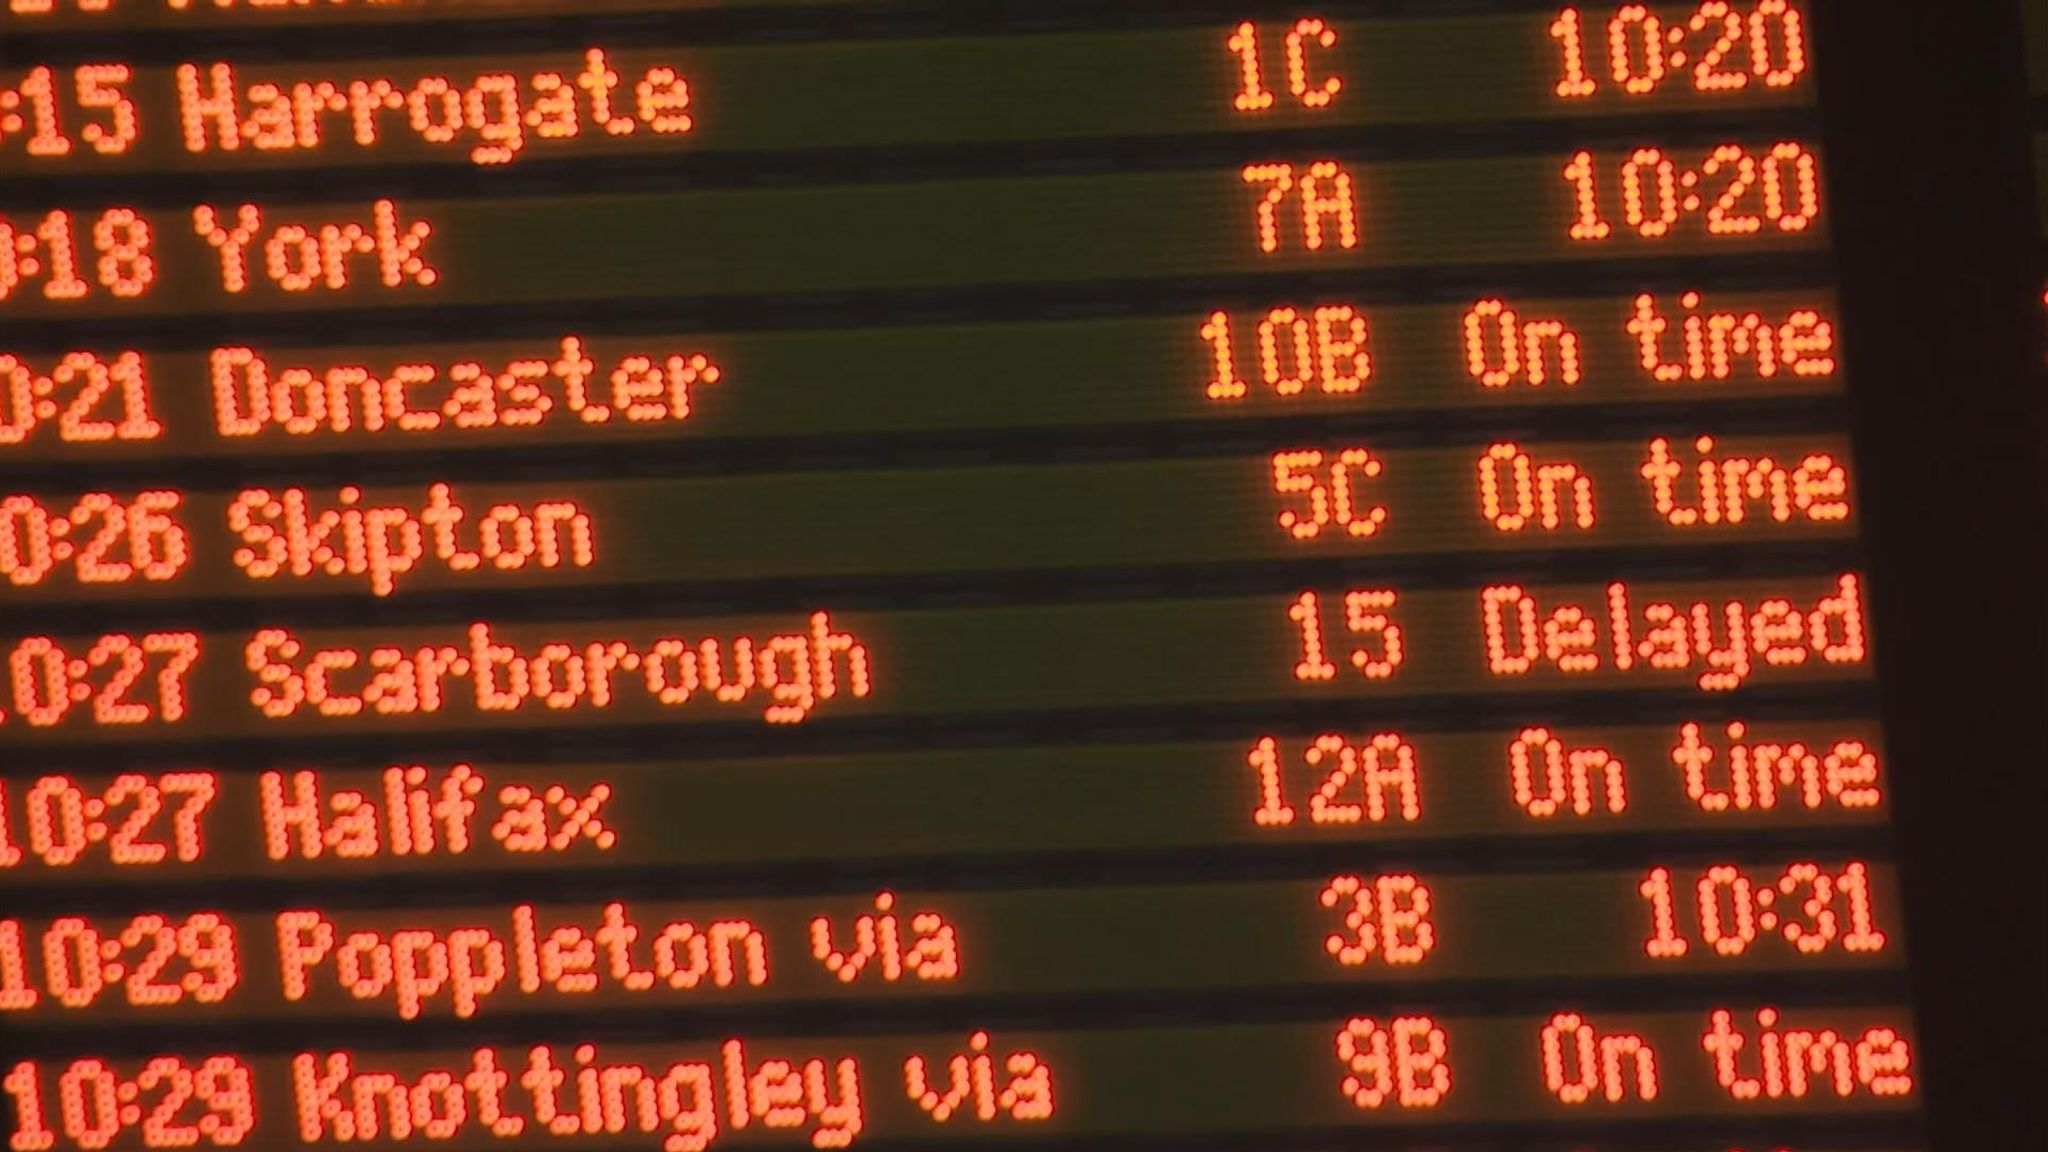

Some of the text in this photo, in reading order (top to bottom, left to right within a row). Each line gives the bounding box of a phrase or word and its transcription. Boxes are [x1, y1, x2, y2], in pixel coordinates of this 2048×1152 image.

[177, 48, 690, 163] Harrogate
[1228, 19, 1340, 111] 1C
[1550, 0, 1804, 96] 10:20
[193, 200, 435, 291] York
[1242, 162, 1358, 251] 7A
[1564, 143, 1817, 239] 10:20
[211, 337, 718, 435] Doncaster
[1200, 306, 1372, 398] 10B
[1463, 299, 1580, 386] On
[1626, 292, 1833, 380] time
[228, 483, 594, 595] Skipton
[1271, 448, 1385, 538] 5C
[1477, 443, 1594, 530] On
[1640, 436, 1847, 524] time
[0, 574, 1863, 725] 0:27 Scarborough 15 Delayed
[260, 765, 614, 859] Halifax
[1248, 733, 1420, 824] 12A
[1510, 728, 1626, 816] On
[1672, 722, 1878, 810] time
[0, 863, 1884, 1018] 10:29 Poppleton via 3B 10:31
[5, 1008, 1911, 1152] 10:29 Knottingley via 9B On time
